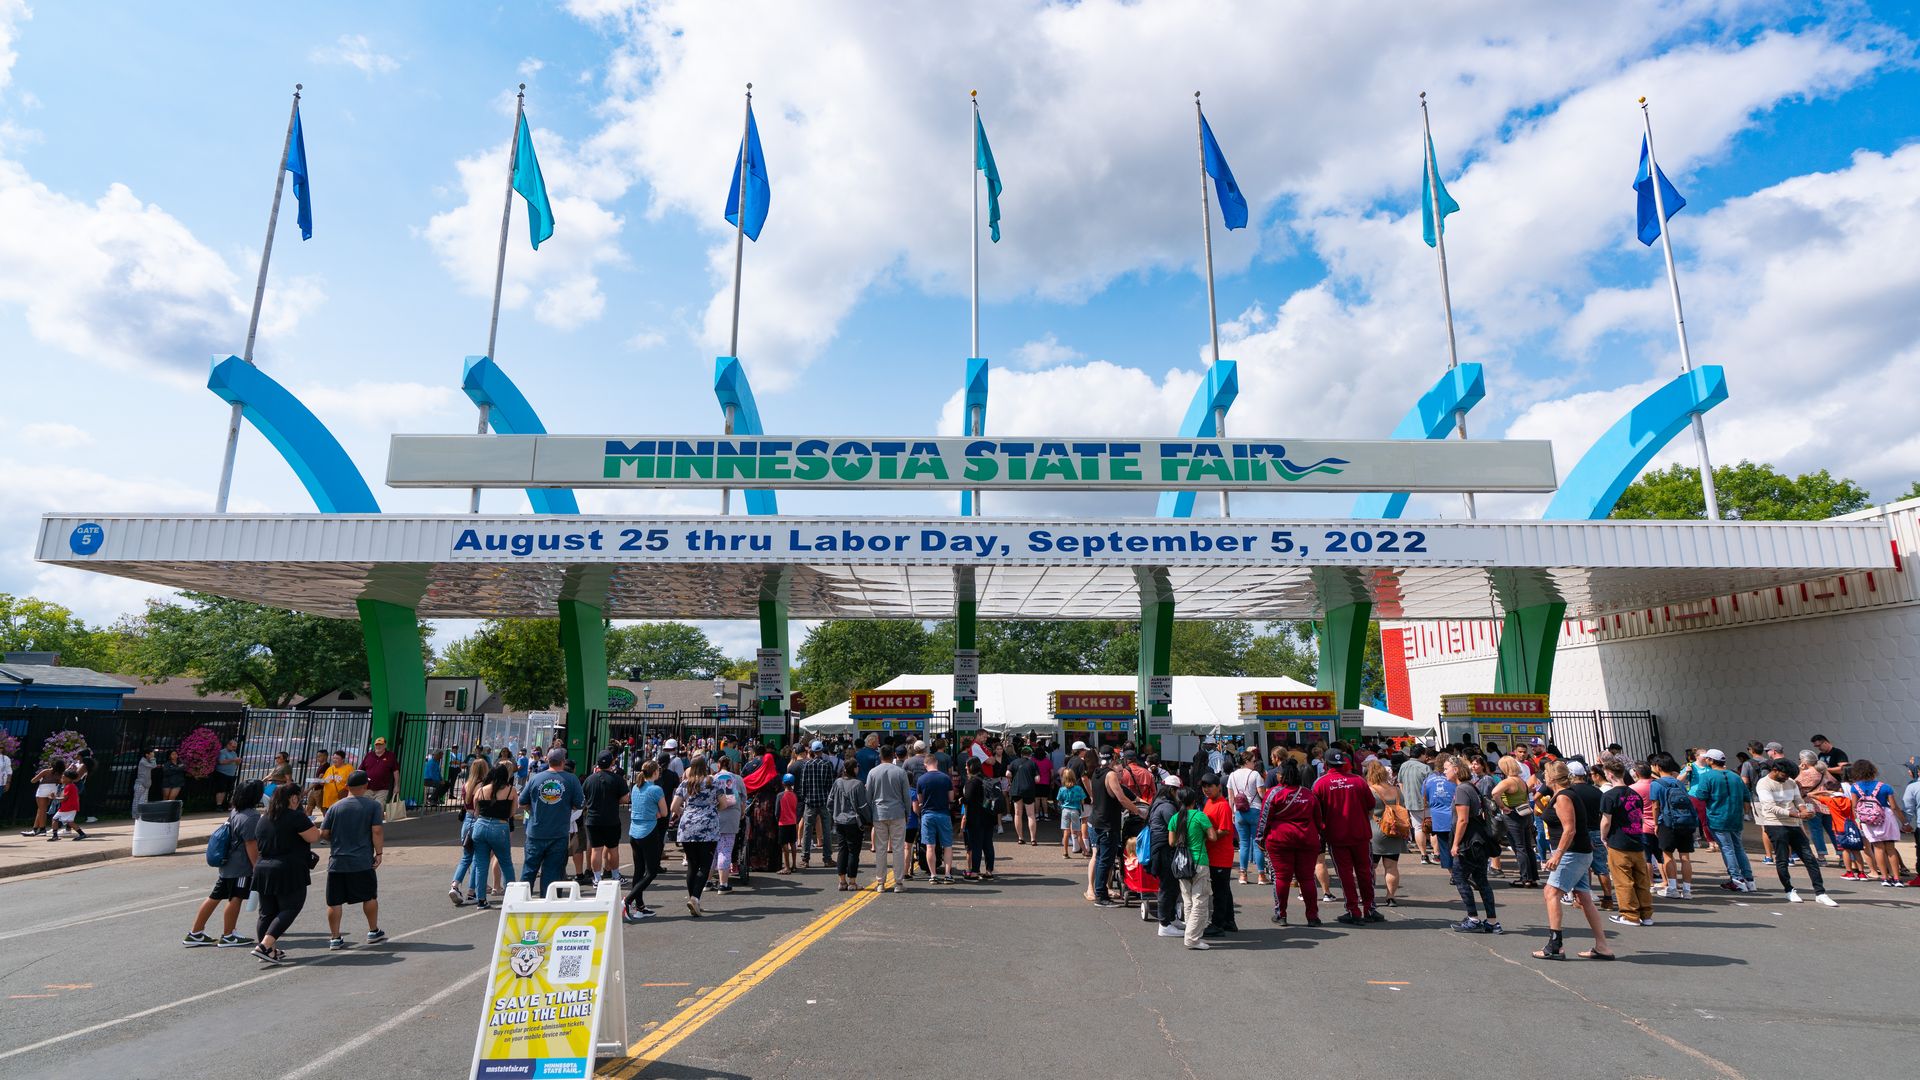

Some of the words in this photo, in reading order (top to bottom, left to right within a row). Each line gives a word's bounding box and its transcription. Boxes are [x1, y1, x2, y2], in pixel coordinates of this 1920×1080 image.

[604, 440, 948, 481] MINNESOTA
[964, 440, 1142, 481] STATE
[1160, 440, 1298, 482] FAIR
[81, 534, 91, 545] 5
[454, 529, 603, 556] August
[619, 529, 668, 551] 25
[686, 530, 771, 551] thru
[790, 530, 910, 551] Labor
[921, 530, 1009, 557] Day,
[1028, 531, 1258, 558] September
[1272, 531, 1308, 557] 5,
[1325, 531, 1425, 552] 2022
[863, 697, 920, 707] TICKETS
[1067, 697, 1124, 708] TICKETS
[1268, 698, 1324, 708] TICKETS
[1481, 701, 1536, 711] TICKETS
[494, 995, 540, 1011] SAVE
[545, 989, 593, 1004] TIME!
[490, 1011, 529, 1026] AVOID
[532, 1007, 557, 1021] THE
[558, 1004, 592, 1018] LINE!
[493, 1029, 503, 1037] Buy
[504, 1027, 523, 1035] regular
[523, 1025, 540, 1033] priced
[485, 1065, 529, 1074] mnstatefair.org
